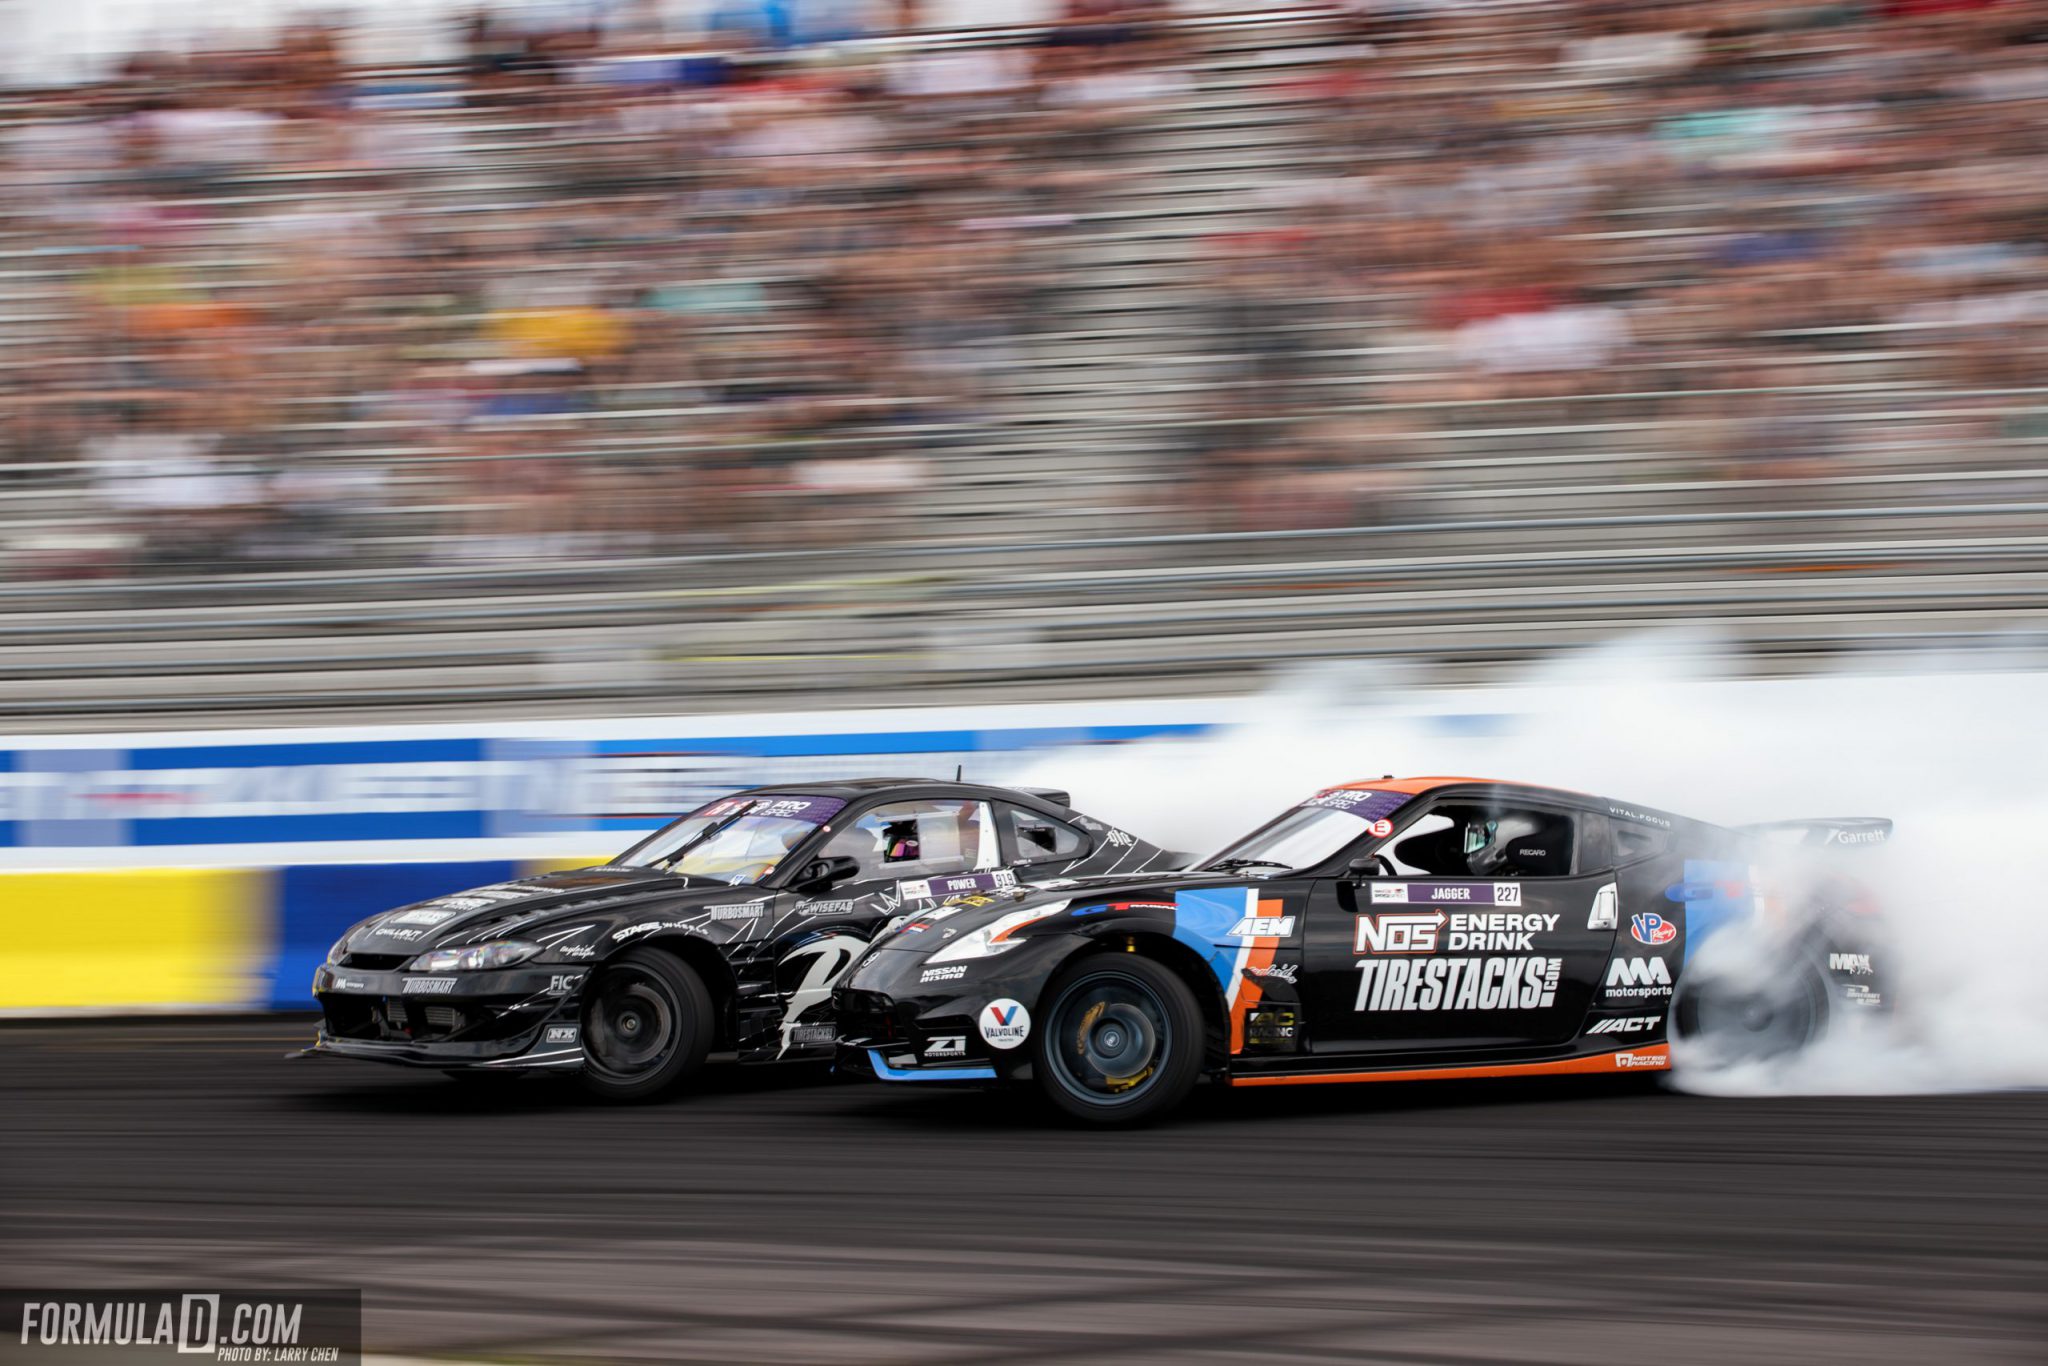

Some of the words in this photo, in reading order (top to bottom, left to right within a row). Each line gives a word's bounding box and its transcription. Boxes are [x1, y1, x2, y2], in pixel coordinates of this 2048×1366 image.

[771, 800, 811, 809] PRO
[1838, 829, 1885, 844] Garrett
[1519, 849, 1546, 857] RECARO
[947, 878, 977, 890] POWER
[1431, 888, 1471, 900] JAGGER
[1497, 887, 1519, 902] 227
[703, 902, 765, 920] TURBOSMART
[809, 900, 854, 914] WISEFAB
[1071, 902, 1135, 916] GT
[1230, 916, 1294, 936] AEM
[1450, 914, 1560, 931] ENERGY
[1631, 913, 1662, 944] VP
[612, 922, 661, 943] STAGE
[1354, 909, 1448, 953] NOS
[1448, 932, 1535, 950] DRINK
[1829, 953, 1870, 970] MAX
[922, 966, 968, 977] NISSAN
[402, 977, 458, 994] TURBOSMART
[550, 975, 574, 990] FIC
[1354, 957, 1546, 1011] TIRESTACKS
[1606, 986, 1672, 998] motorsports
[548, 1028, 574, 1039] NX
[984, 1025, 1025, 1039] VALVOLINE
